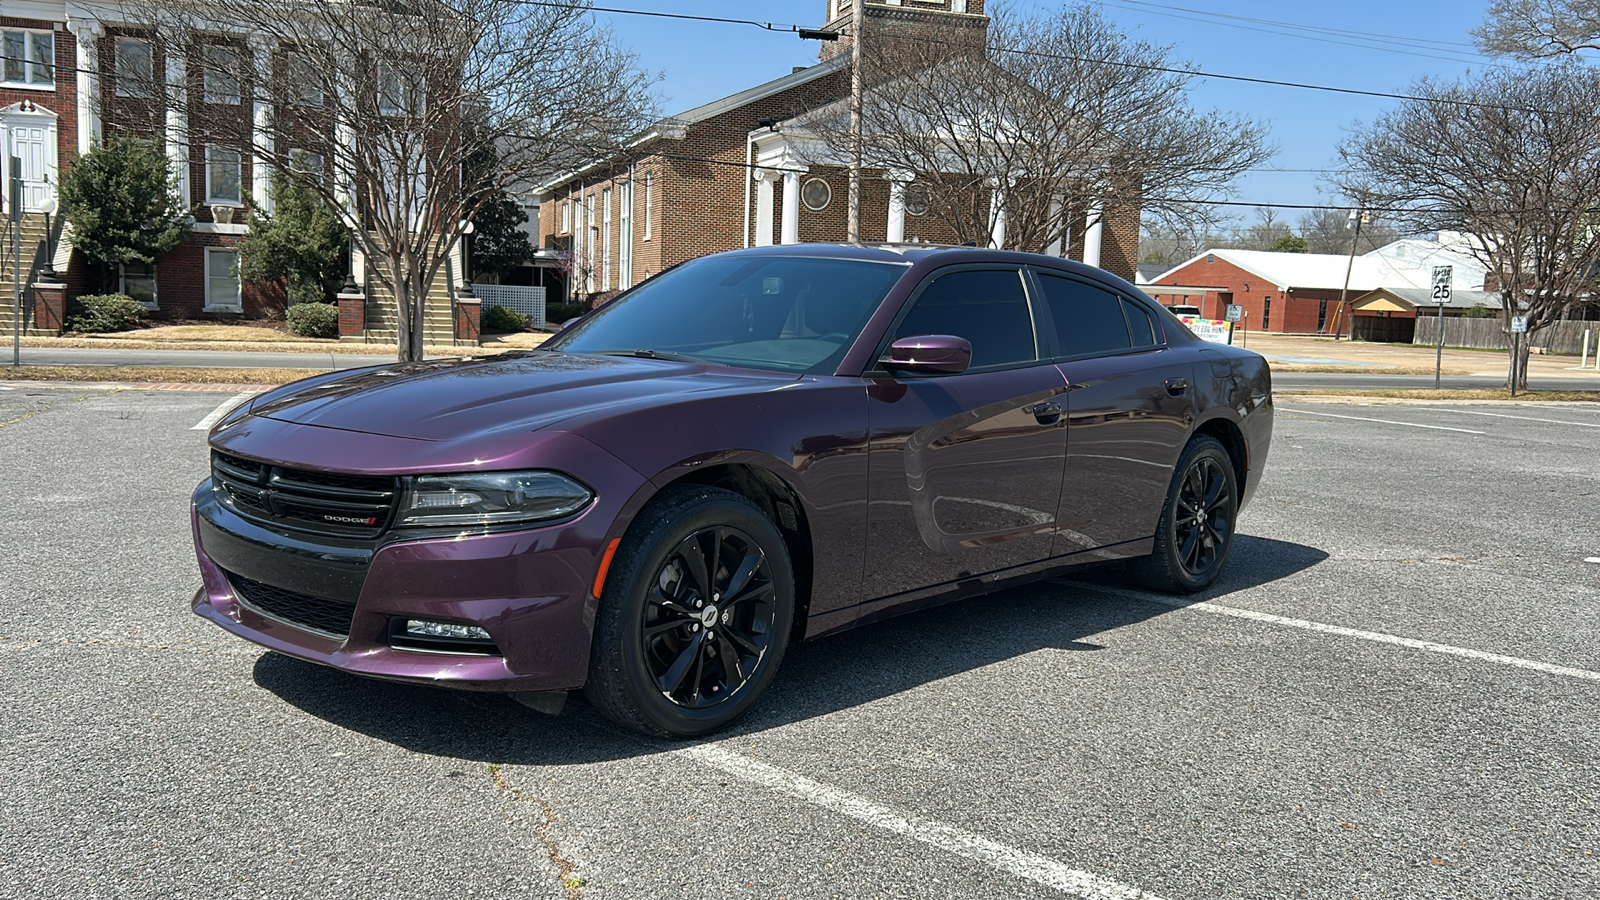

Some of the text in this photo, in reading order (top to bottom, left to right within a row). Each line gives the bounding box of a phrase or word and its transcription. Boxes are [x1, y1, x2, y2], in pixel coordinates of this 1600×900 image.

[1433, 285, 1450, 299] 25
[1201, 325, 1211, 333] EGG
[1212, 326, 1225, 334] HUNT
[324, 515, 369, 524] DODGE
